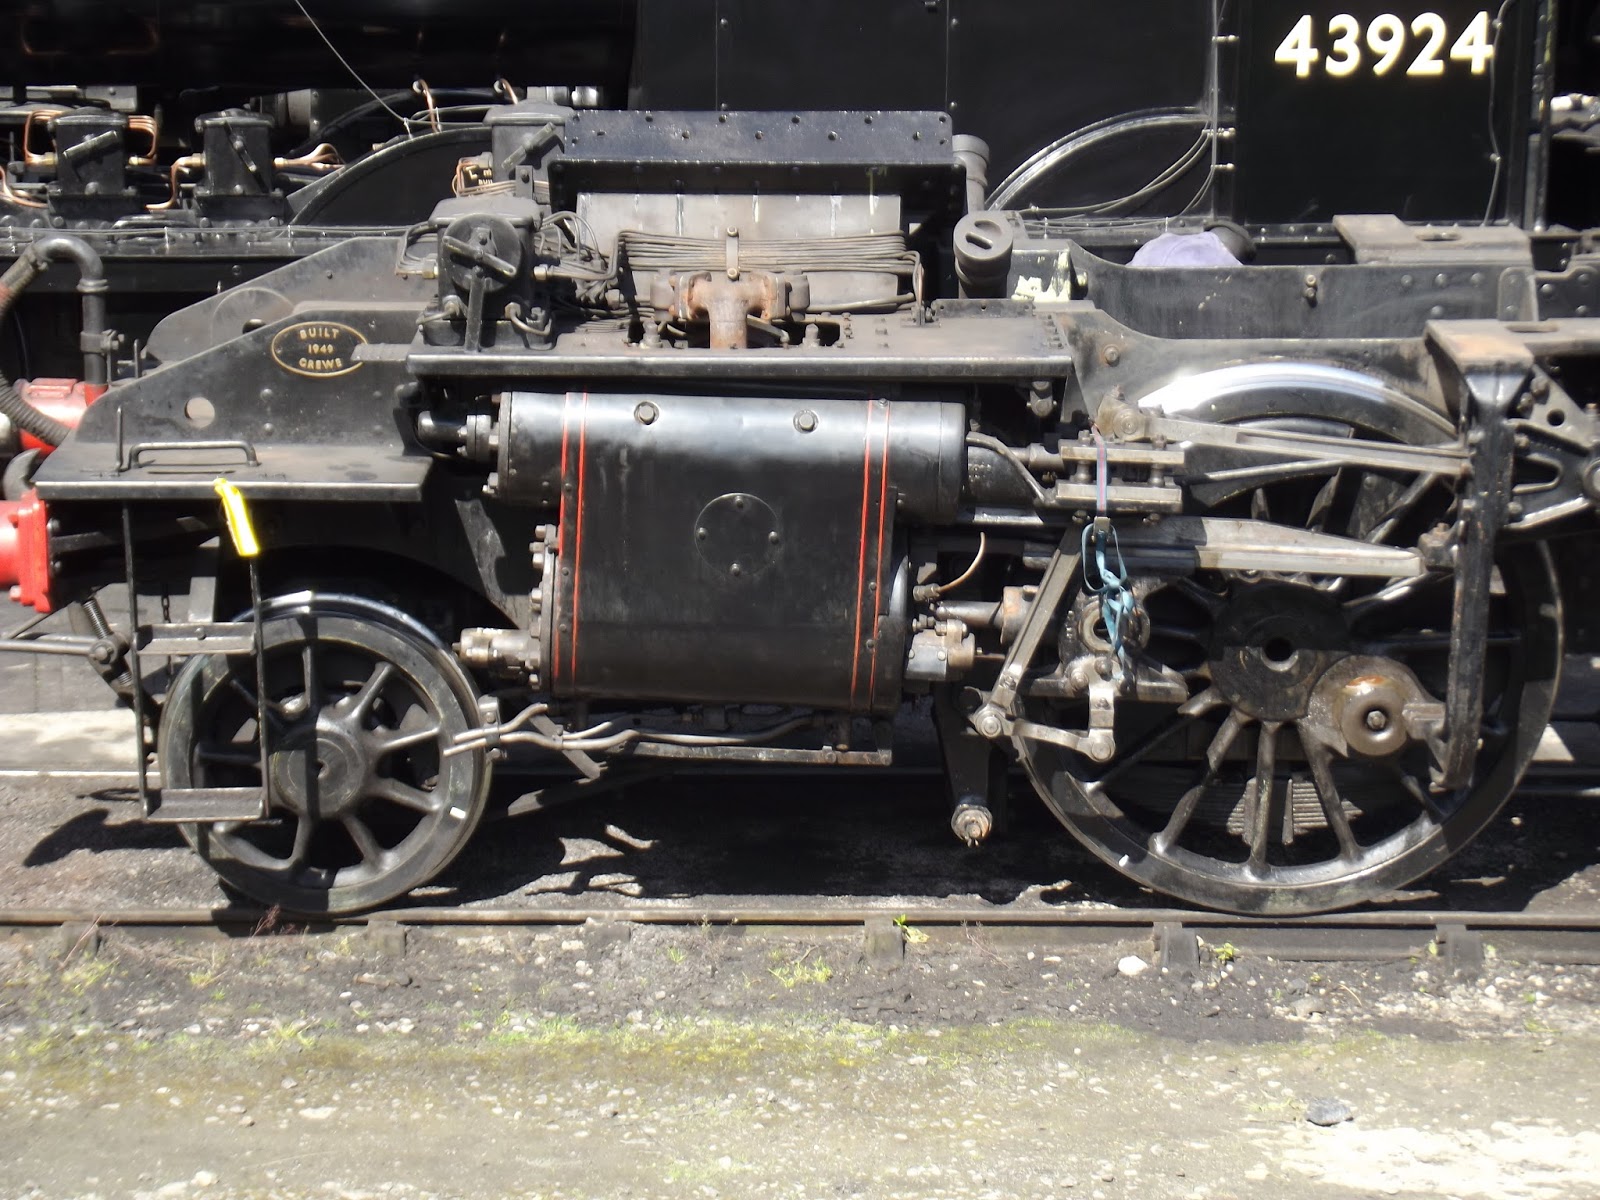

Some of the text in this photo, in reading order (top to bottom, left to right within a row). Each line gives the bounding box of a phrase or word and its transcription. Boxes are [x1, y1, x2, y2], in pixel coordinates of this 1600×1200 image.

[1274, 11, 1494, 77] 43924
[299, 327, 340, 340] BUILT
[308, 344, 334, 354] 1949
[299, 357, 343, 370] CREWE
